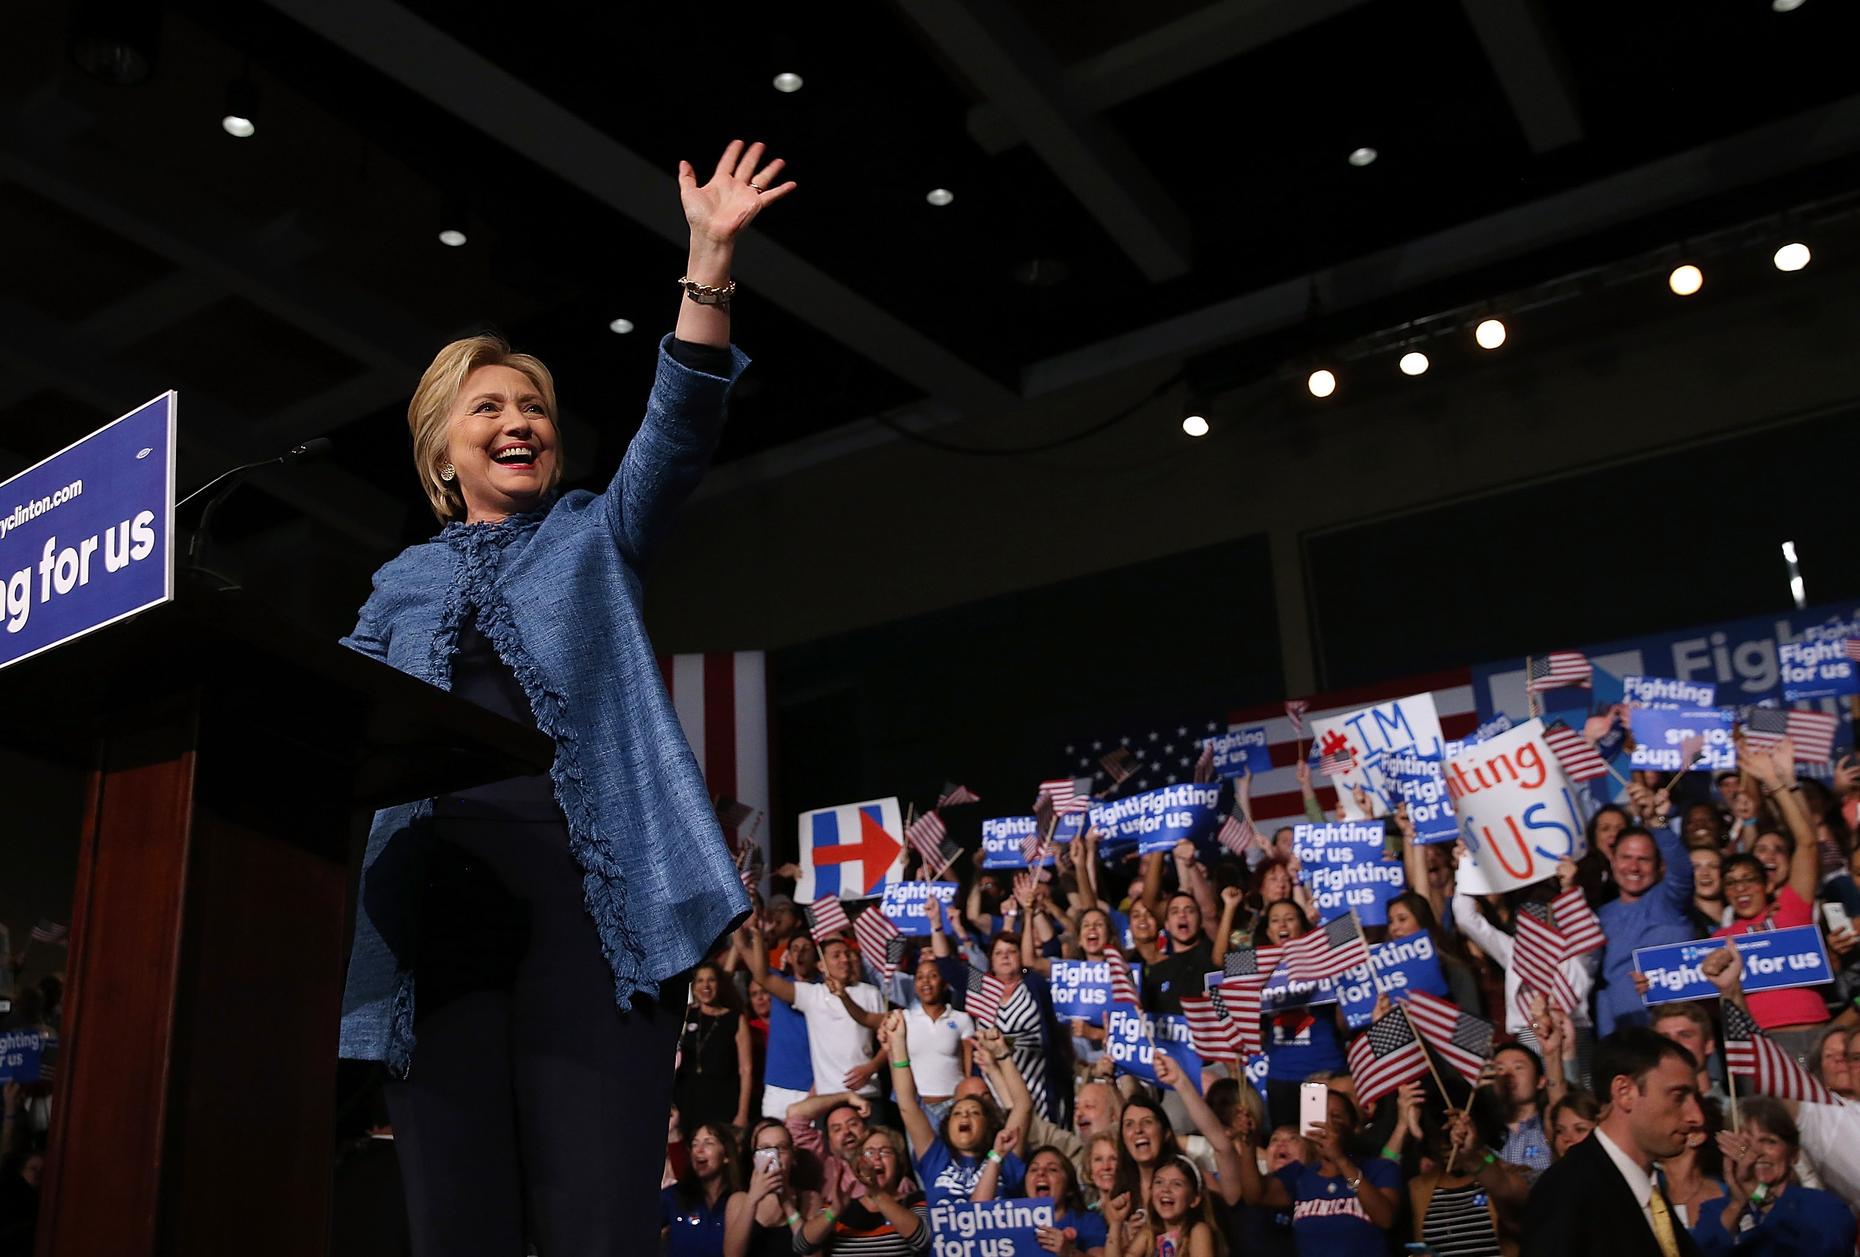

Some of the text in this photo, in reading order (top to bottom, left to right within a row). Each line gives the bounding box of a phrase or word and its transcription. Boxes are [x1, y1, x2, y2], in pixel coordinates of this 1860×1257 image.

[39, 535, 99, 604] for
[104, 510, 156, 573] us
[1782, 662, 1851, 683] for us
[1623, 676, 1714, 707] Fighting
[1212, 750, 1249, 768] or us
[1139, 784, 1219, 815] Fighting
[1406, 800, 1439, 823] for
[1137, 811, 1194, 835] for us
[1294, 823, 1384, 847] Fighting
[981, 837, 1024, 853] for u
[1292, 843, 1354, 863] for us
[1312, 861, 1404, 891] Fighting
[883, 881, 957, 904] Fighting
[1312, 887, 1376, 909] for us
[880, 900, 906, 918] for
[1747, 953, 1786, 976] for
[1788, 951, 1822, 971] us
[1050, 984, 1108, 1005] for us
[1336, 970, 1409, 1007] for us
[1106, 1034, 1137, 1063] for
[930, 1200, 1052, 1238] Fighting
[932, 1233, 1016, 1257] for us
